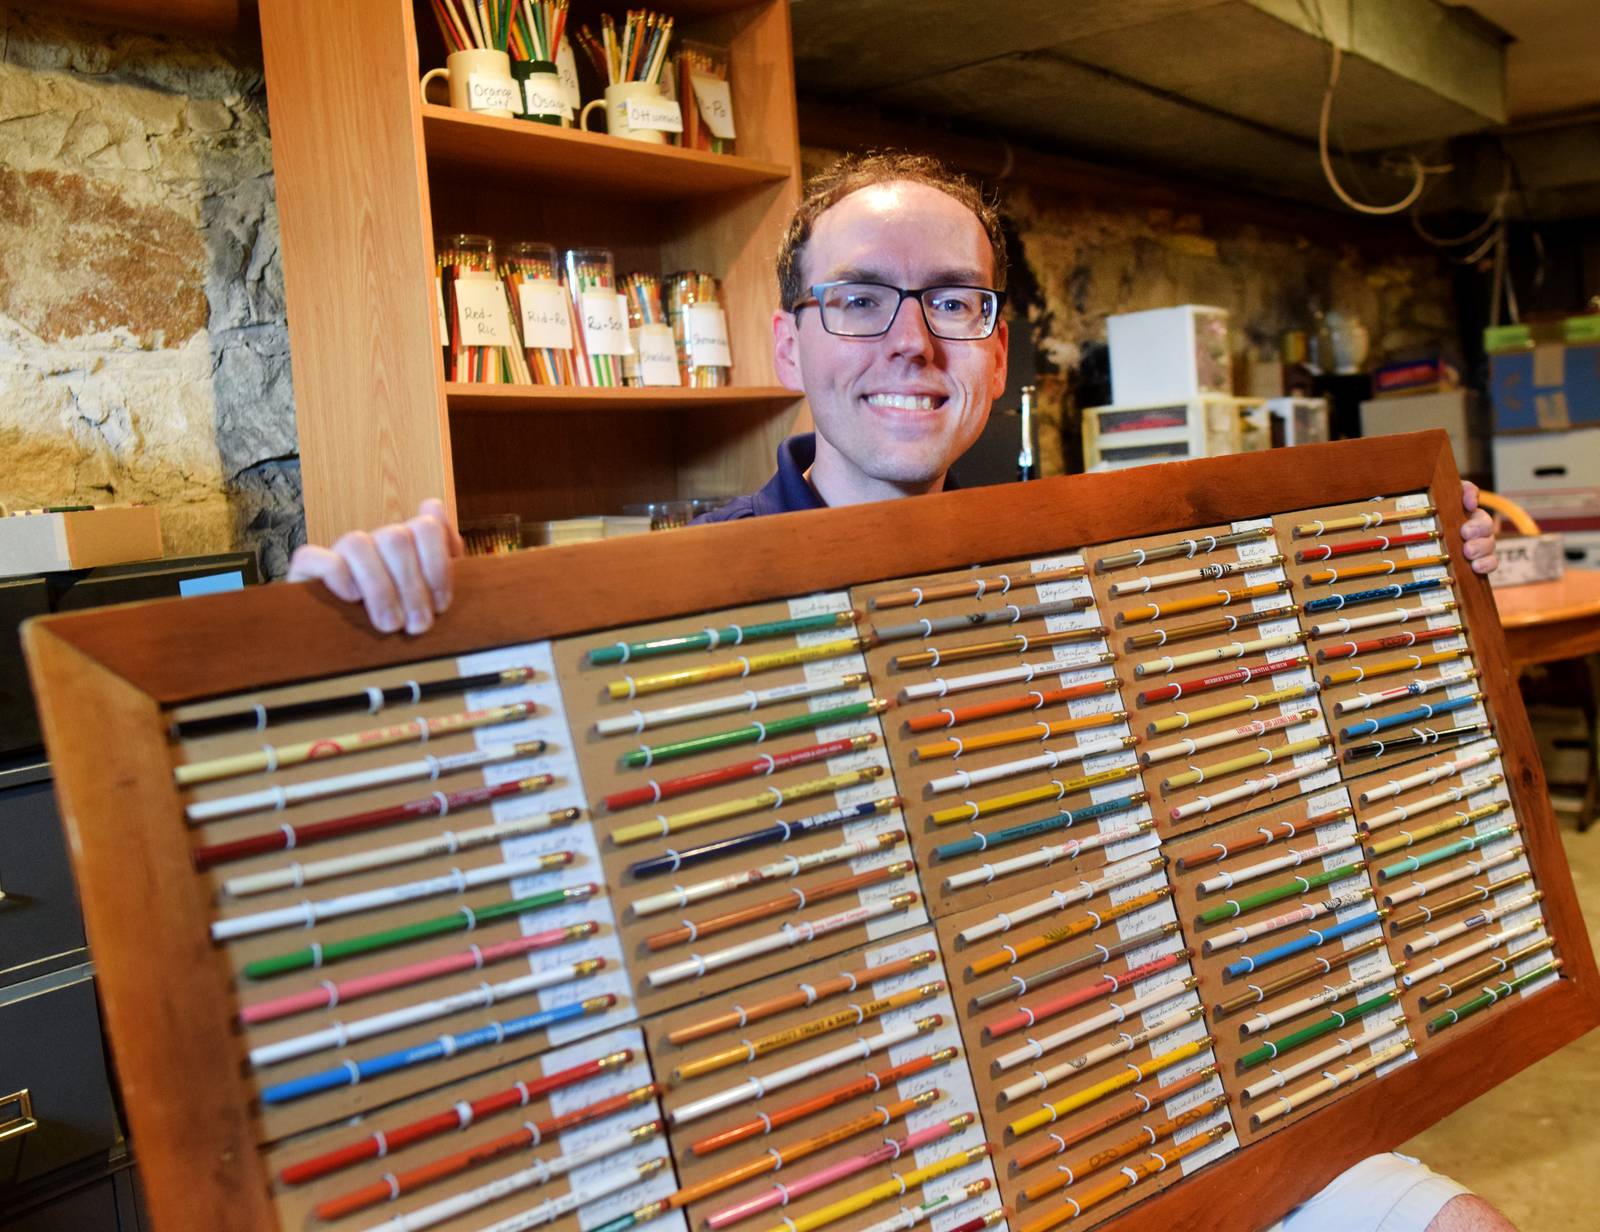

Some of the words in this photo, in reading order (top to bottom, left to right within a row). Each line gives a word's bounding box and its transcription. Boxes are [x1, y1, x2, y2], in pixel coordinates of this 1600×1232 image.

[1203, 675, 1223, 685] HERBERT
[1223, 672, 1242, 681] HOOVER
[1270, 661, 1288, 671] MUSEUM
